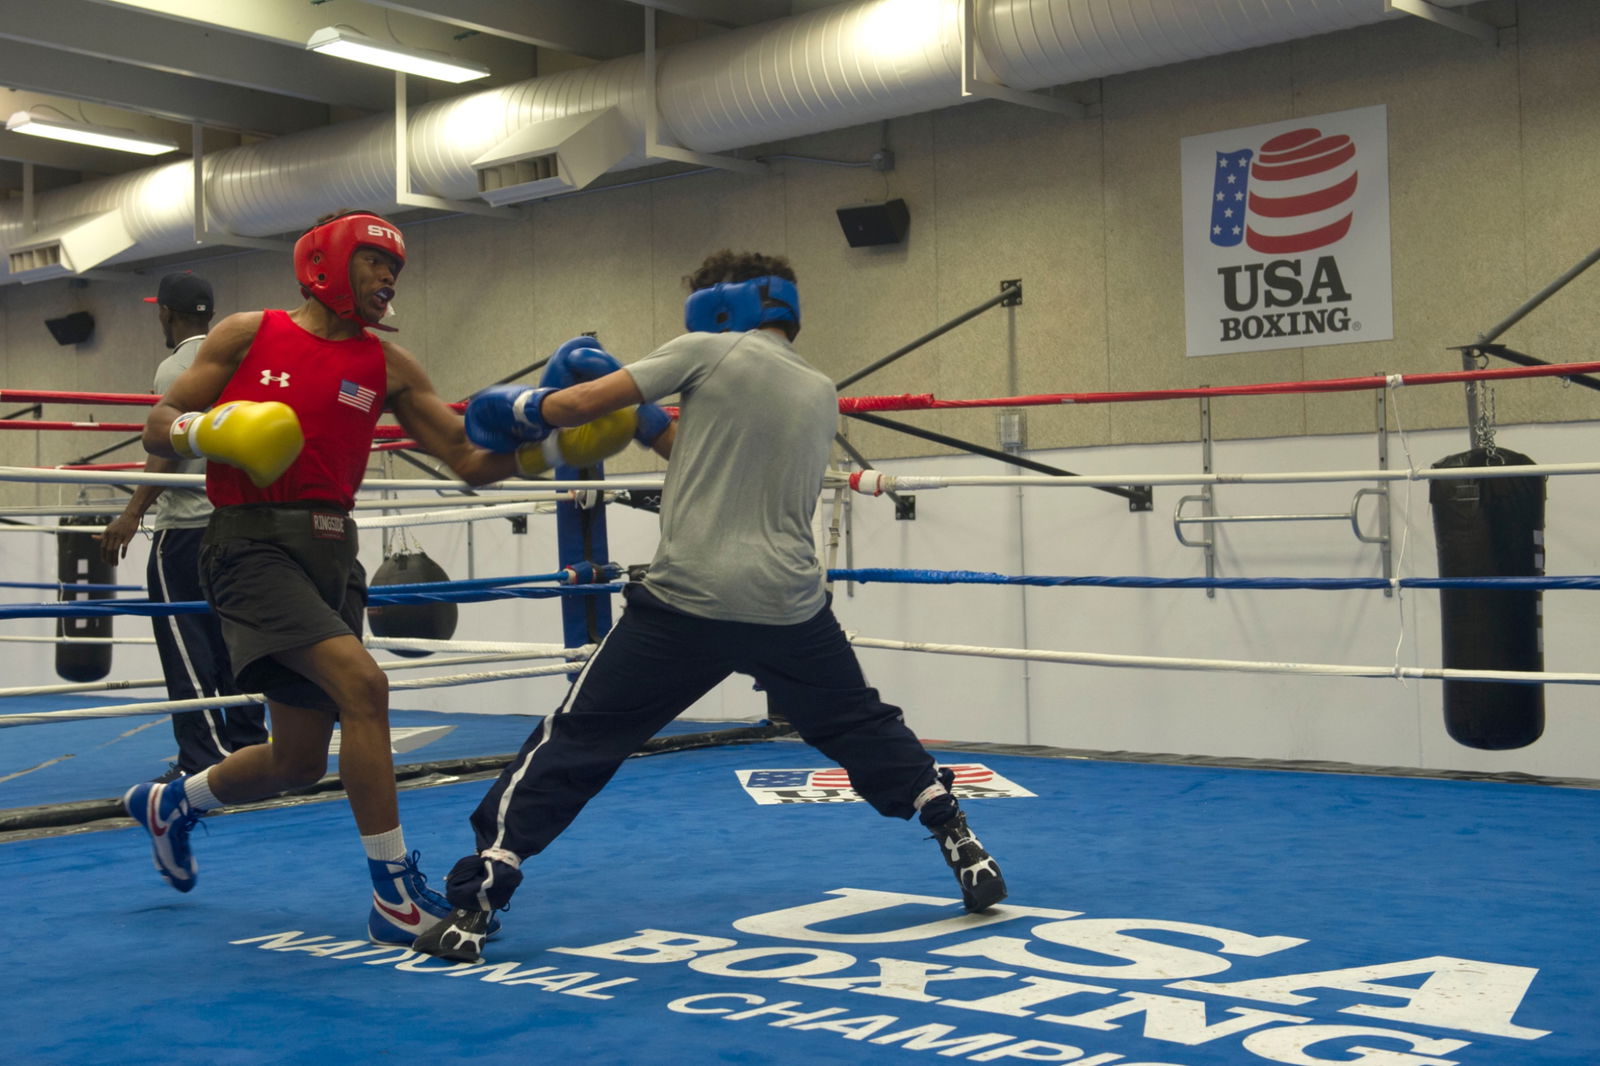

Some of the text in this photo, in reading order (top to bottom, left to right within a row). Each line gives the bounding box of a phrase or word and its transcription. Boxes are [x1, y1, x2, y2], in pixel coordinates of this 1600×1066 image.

[1217, 255, 1353, 312] USA
[1220, 307, 1352, 342] BOXING
[548, 929, 1473, 1066] BOXING
[733, 887, 1552, 1040] USA
